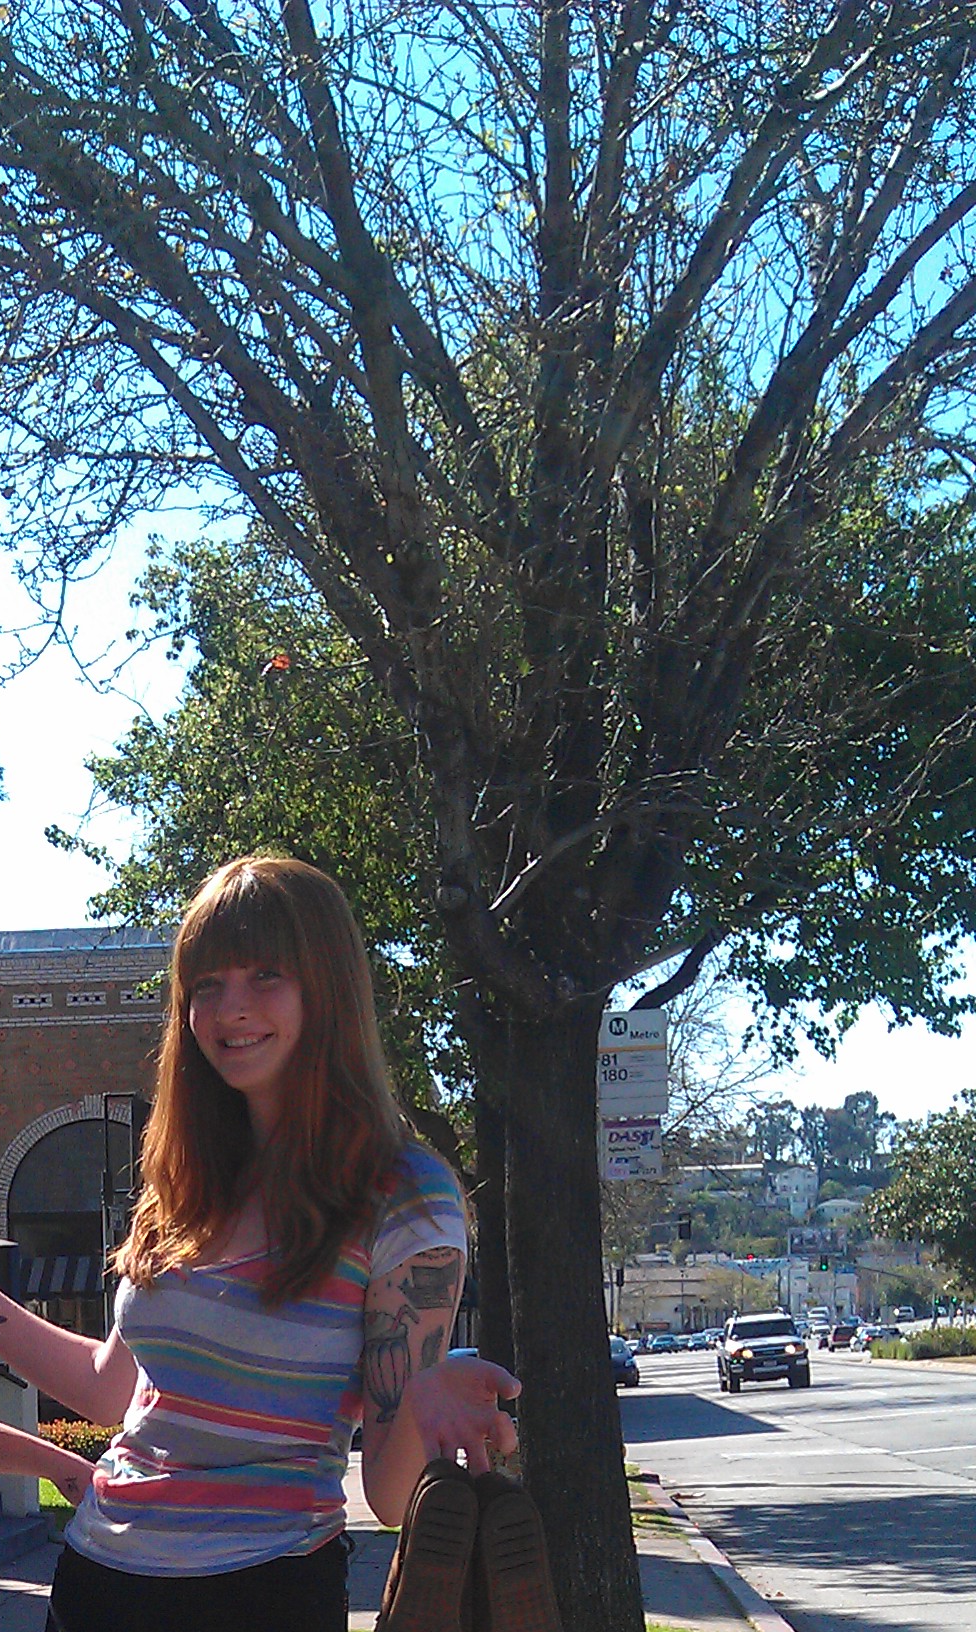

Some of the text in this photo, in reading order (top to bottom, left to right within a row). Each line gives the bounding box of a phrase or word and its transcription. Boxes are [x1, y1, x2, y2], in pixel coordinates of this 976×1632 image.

[629, 1030, 660, 1040] Metro
[601, 1053, 618, 1067] 81
[601, 1068, 628, 1082] 180
